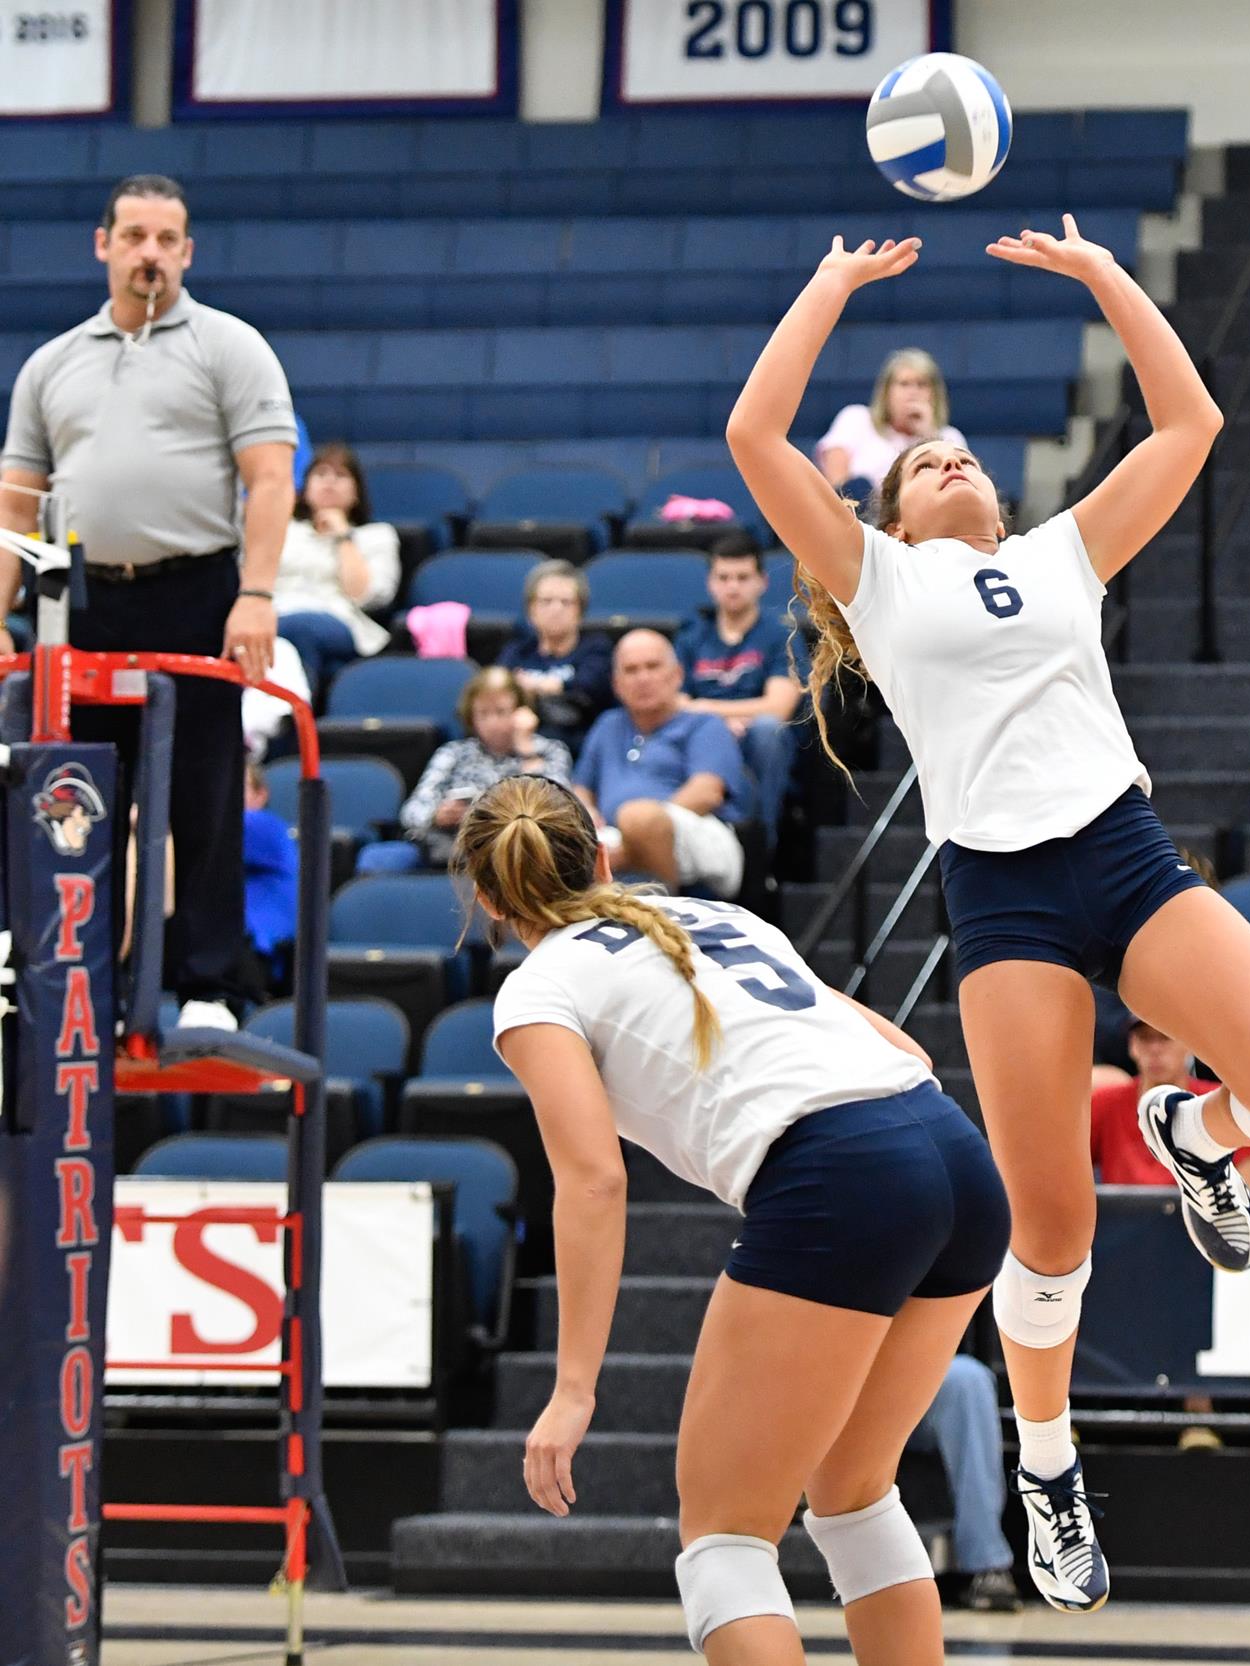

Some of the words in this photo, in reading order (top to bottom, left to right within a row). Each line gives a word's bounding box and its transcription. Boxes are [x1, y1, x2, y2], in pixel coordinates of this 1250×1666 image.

[684, 0, 874, 58] 2009
[973, 568, 1024, 619] 6
[688, 921, 817, 1012] 5
[53, 872, 99, 1632] PATRIOTS
